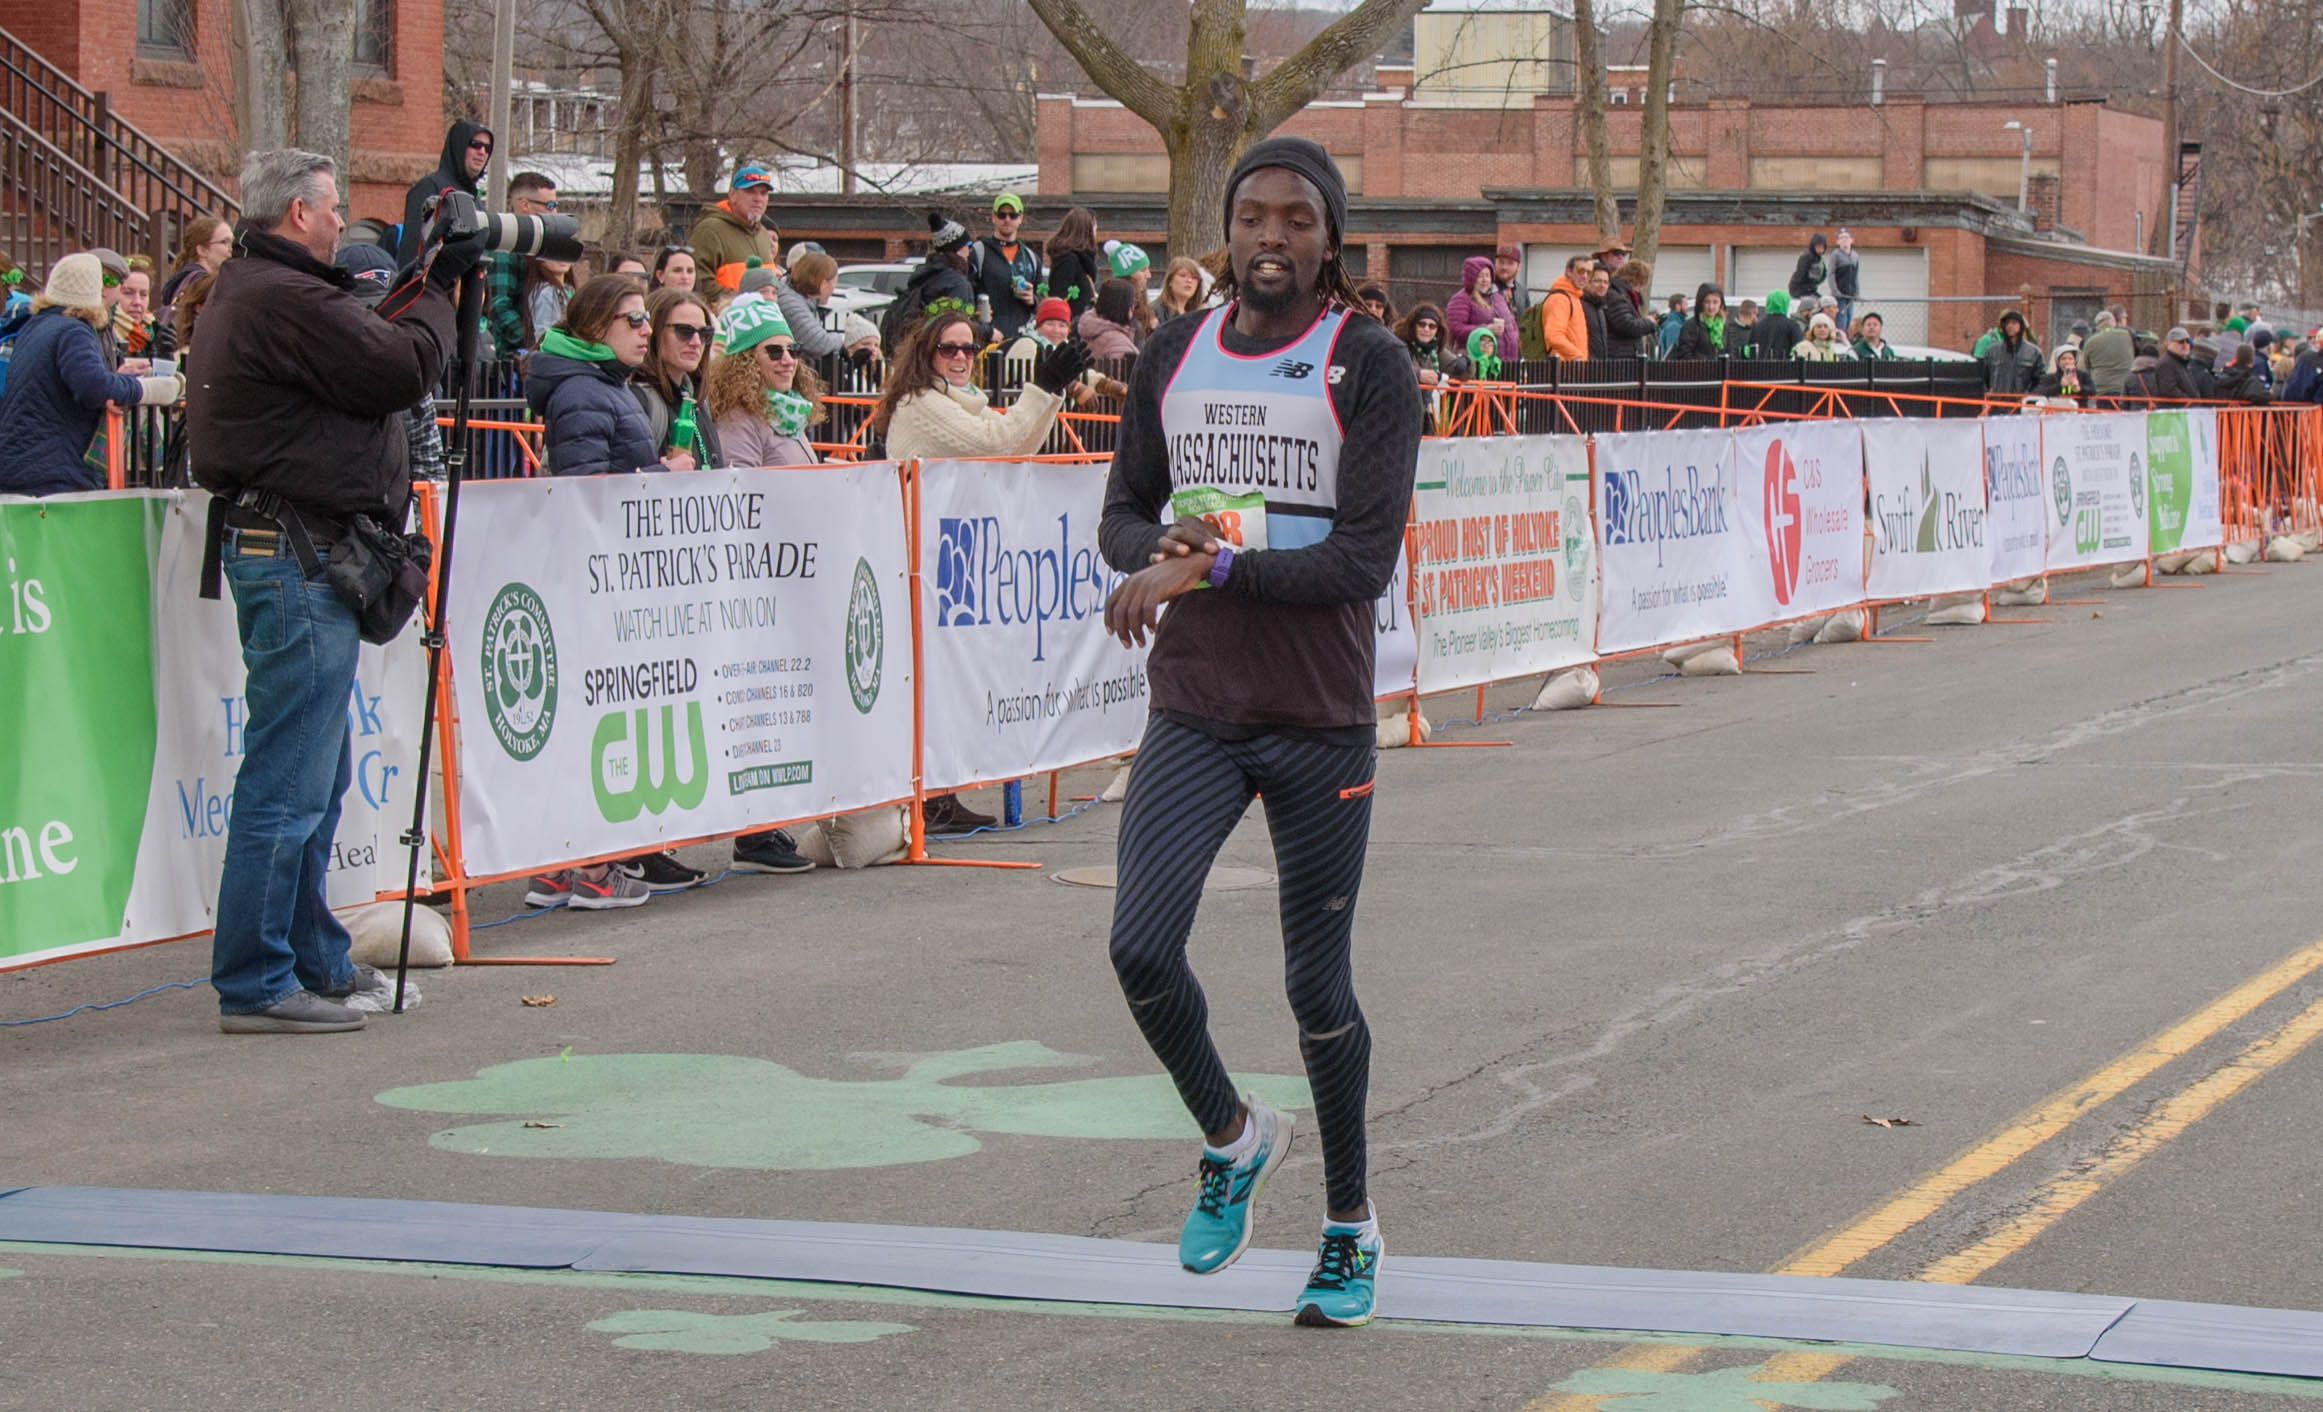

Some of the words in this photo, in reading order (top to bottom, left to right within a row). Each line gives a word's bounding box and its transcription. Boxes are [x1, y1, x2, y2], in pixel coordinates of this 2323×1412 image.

[722, 304, 785, 345] IRIS
[1204, 403, 1267, 426] WESTERN
[1441, 457, 1486, 498] Welcome
[1488, 472, 1498, 497] to
[1499, 457, 1513, 495] the
[1514, 455, 1543, 504] Paper
[1544, 453, 1565, 505] City
[1803, 457, 1822, 489] C&S
[621, 499, 663, 538] THE
[670, 493, 765, 535] HOLYOKE
[1627, 461, 1729, 568] PeoplesBank
[1805, 504, 1848, 537] Wholesale
[1877, 485, 1913, 555] Swift
[1945, 491, 1984, 550] River
[1418, 519, 1459, 567] PROUD
[1462, 515, 1491, 561] HOST
[1494, 513, 1509, 559] OF
[1512, 510, 1560, 557] HOLYOKE
[588, 553, 615, 594] ST.
[618, 543, 718, 591] PATRICK'S
[1440, 564, 1499, 615] PATRICK'S
[1501, 558, 1555, 607] WEEKEND
[1806, 554, 1839, 585] Grocers
[9, 556, 52, 634] is
[484, 590, 519, 658] PATRICK'S
[614, 607, 662, 643] WATCH
[665, 603, 695, 637] LIVE
[699, 601, 713, 633] AT
[756, 596, 776, 627] ON
[1433, 631, 1447, 660] The
[1449, 629, 1477, 657] Pioneer
[1505, 620, 1532, 652] Biggest
[1533, 616, 1580, 644] Homecoming
[585, 657, 697, 706] SPRINGFIELD
[758, 658, 788, 674] CHANNEL
[790, 657, 811, 671] 22.2
[746, 686, 777, 702] CHANNELS
[779, 685, 788, 699] 16
[797, 682, 814, 697] 820
[986, 688, 996, 726] A
[998, 687, 1042, 733] passion
[1043, 682, 1061, 718] for
[1062, 676, 1089, 713] what
[1091, 678, 1100, 706] is
[1103, 663, 1146, 714] possible
[537, 709, 552, 737] MA
[746, 711, 777, 729] CHANNELS
[779, 711, 788, 726] 13
[796, 709, 812, 724] 788
[591, 700, 709, 823] CW
[608, 756, 629, 777] THE
